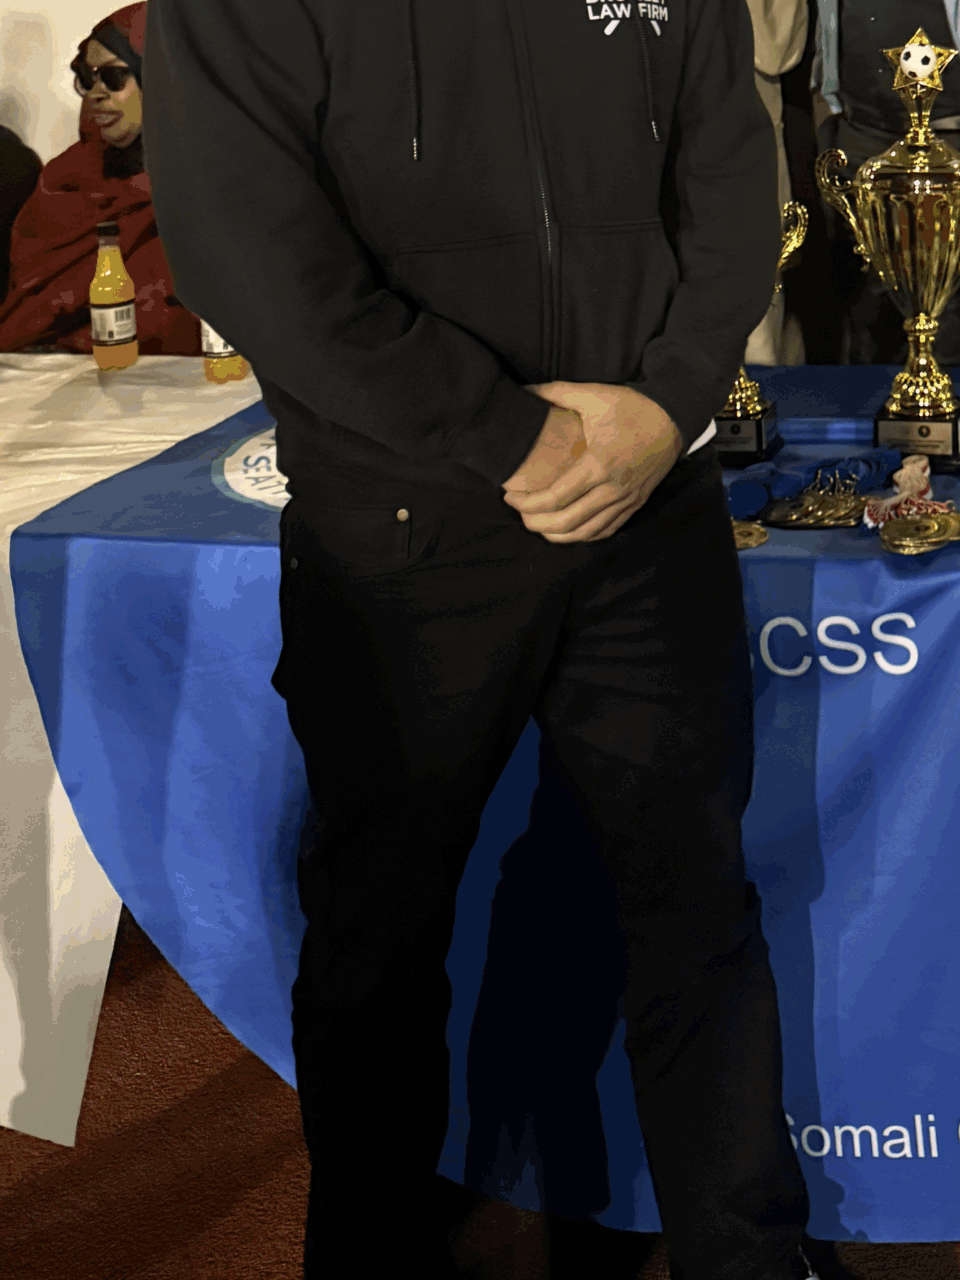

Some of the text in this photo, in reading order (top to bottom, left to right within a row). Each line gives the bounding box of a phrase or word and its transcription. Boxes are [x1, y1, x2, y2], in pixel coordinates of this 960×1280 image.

[587, 3, 669, 22] LAW FIRM
[750, 612, 920, 677] CSS
